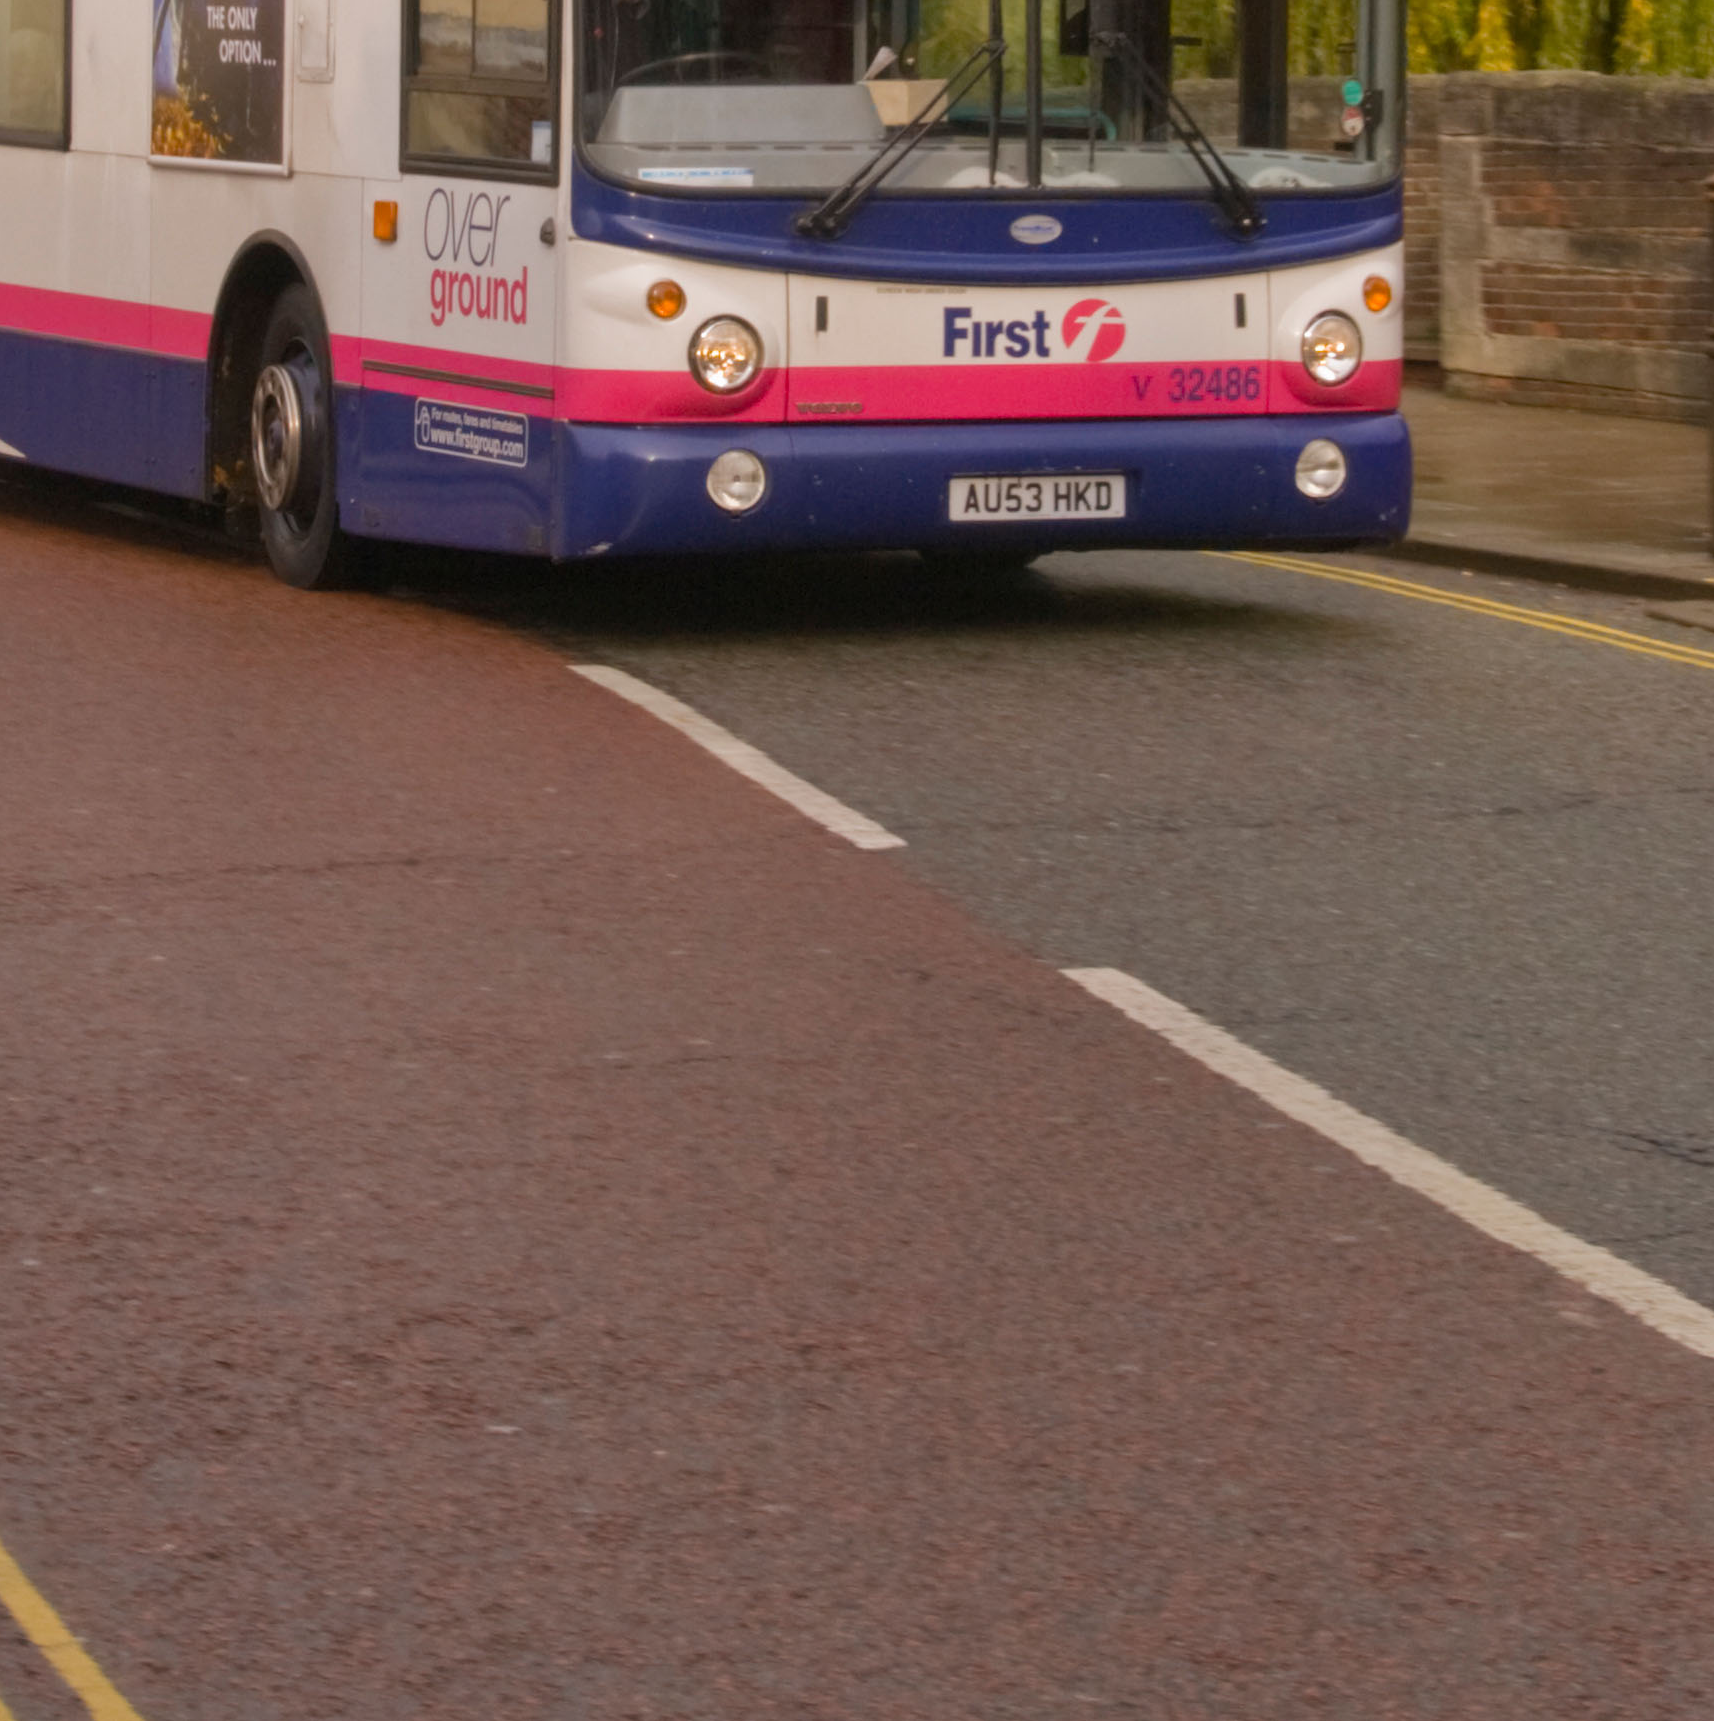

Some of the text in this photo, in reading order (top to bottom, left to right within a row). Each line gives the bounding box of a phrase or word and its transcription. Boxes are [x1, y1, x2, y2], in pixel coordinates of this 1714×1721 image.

[206, 6, 258, 31] THE ONLY
[423, 187, 511, 267] over
[430, 266, 528, 327] ground
[942, 306, 1051, 358] First
[1167, 366, 1262, 403] 32486
[430, 427, 525, 458] www.firstgroup.com
[964, 481, 1112, 513] AU53 HKD
